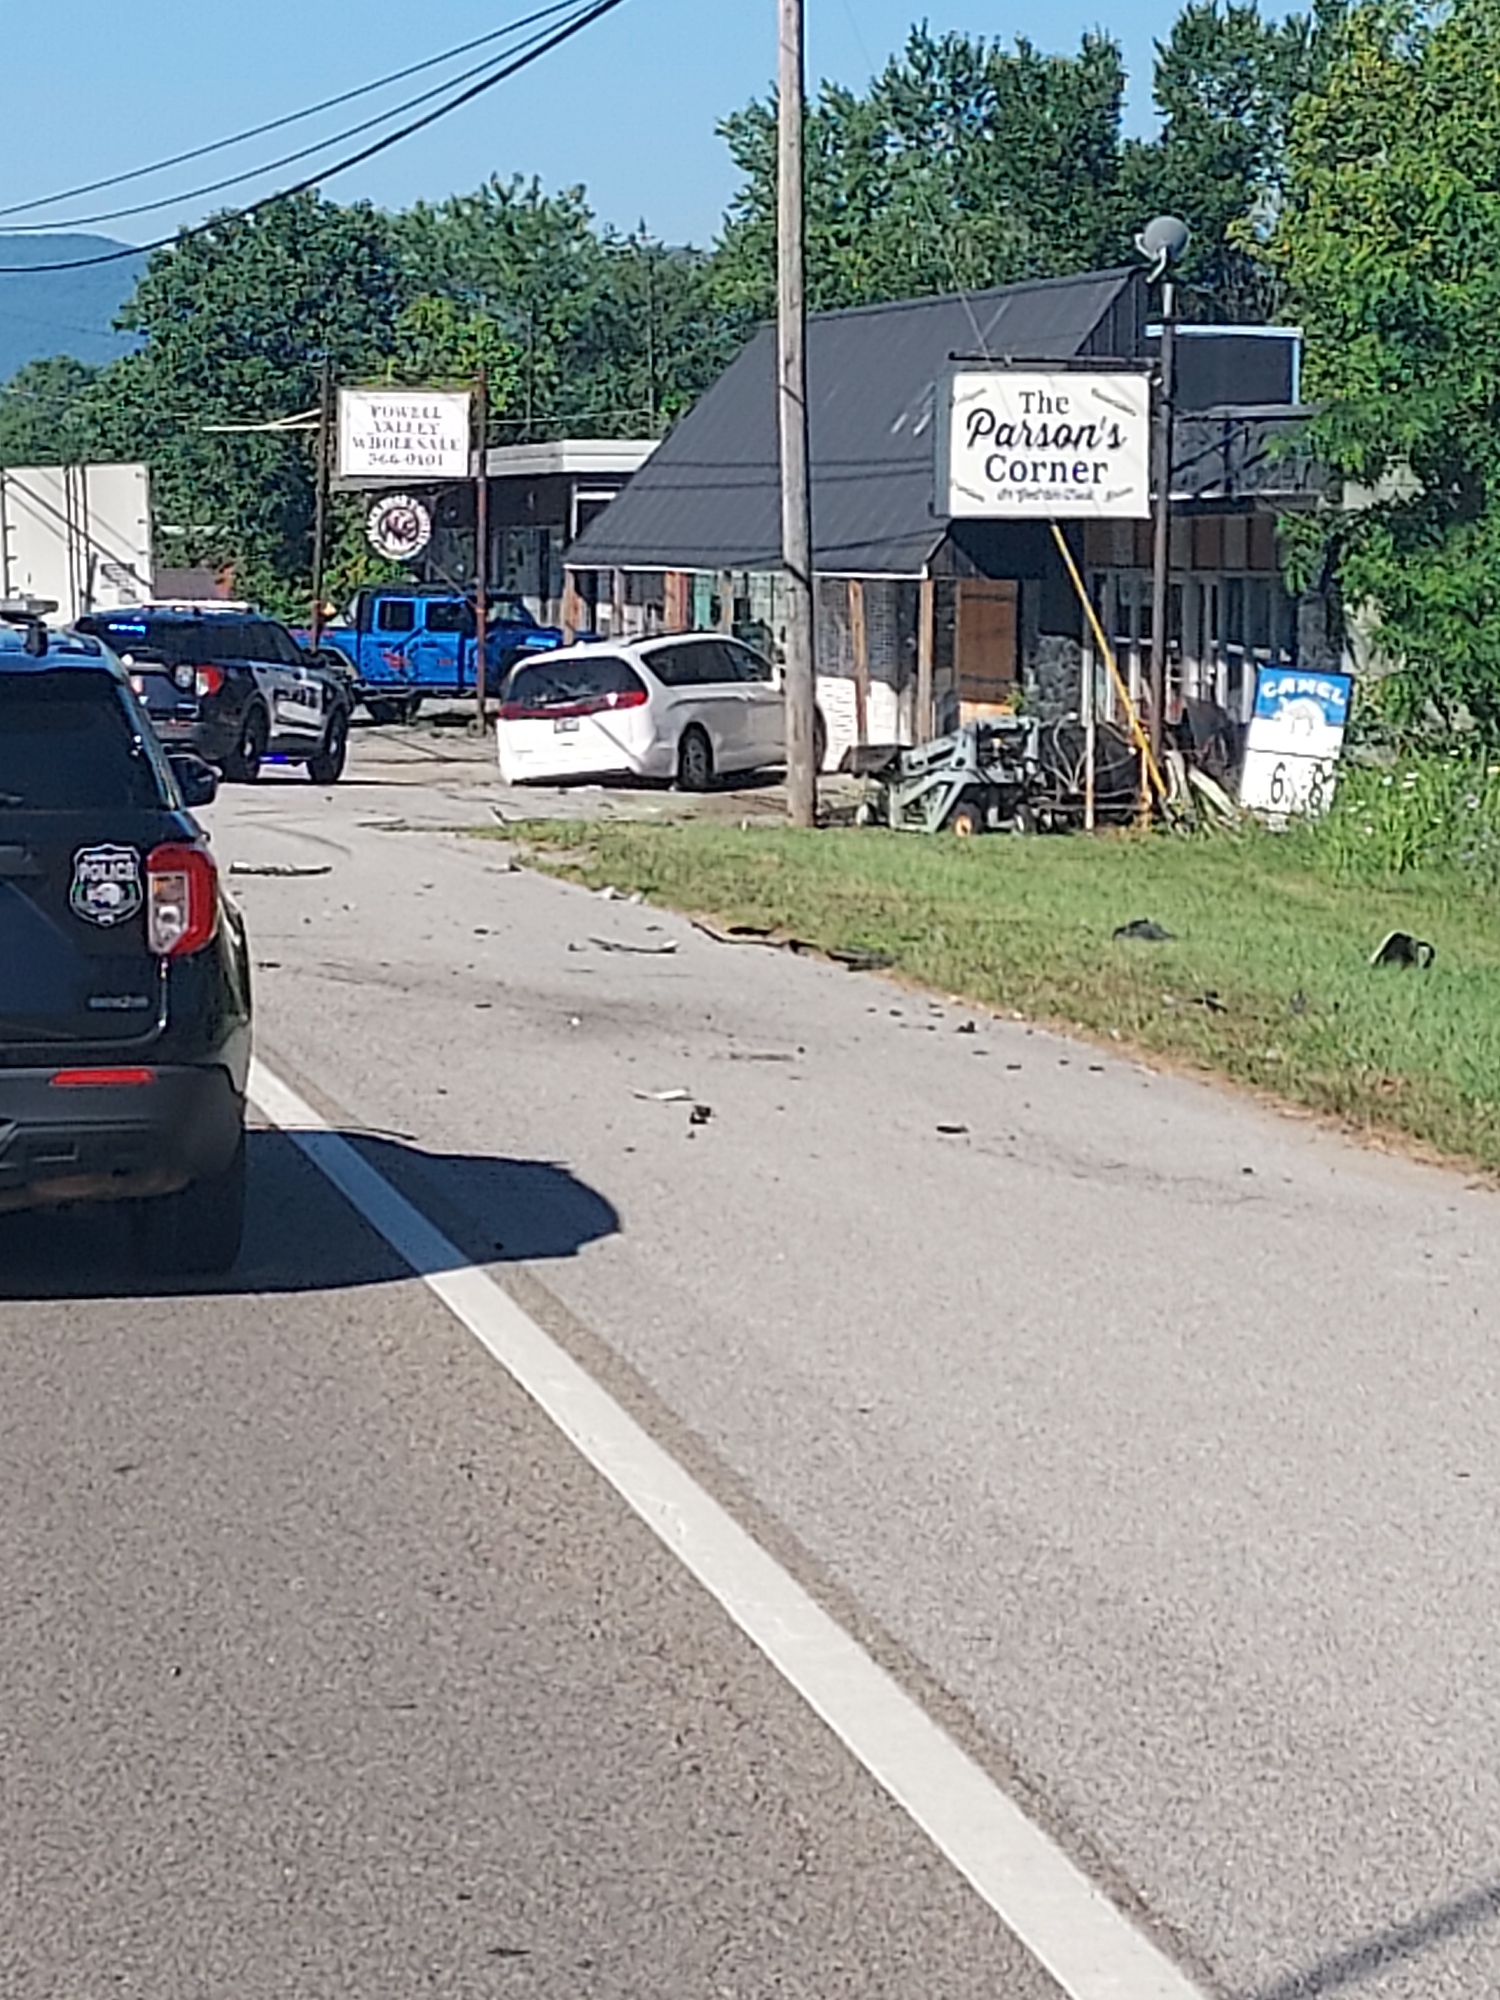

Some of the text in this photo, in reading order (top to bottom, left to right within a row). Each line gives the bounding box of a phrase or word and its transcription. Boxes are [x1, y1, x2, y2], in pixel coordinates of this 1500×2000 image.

[371, 404, 443, 419] POWELL
[1018, 389, 1070, 415] The
[373, 420, 441, 436] VALLEY
[966, 407, 1128, 450] Parson's
[352, 435, 461, 452] WHOLESALE
[985, 453, 1109, 484] Corner
[1262, 676, 1345, 706] CAMEL
[78, 861, 135, 882] POLICE
